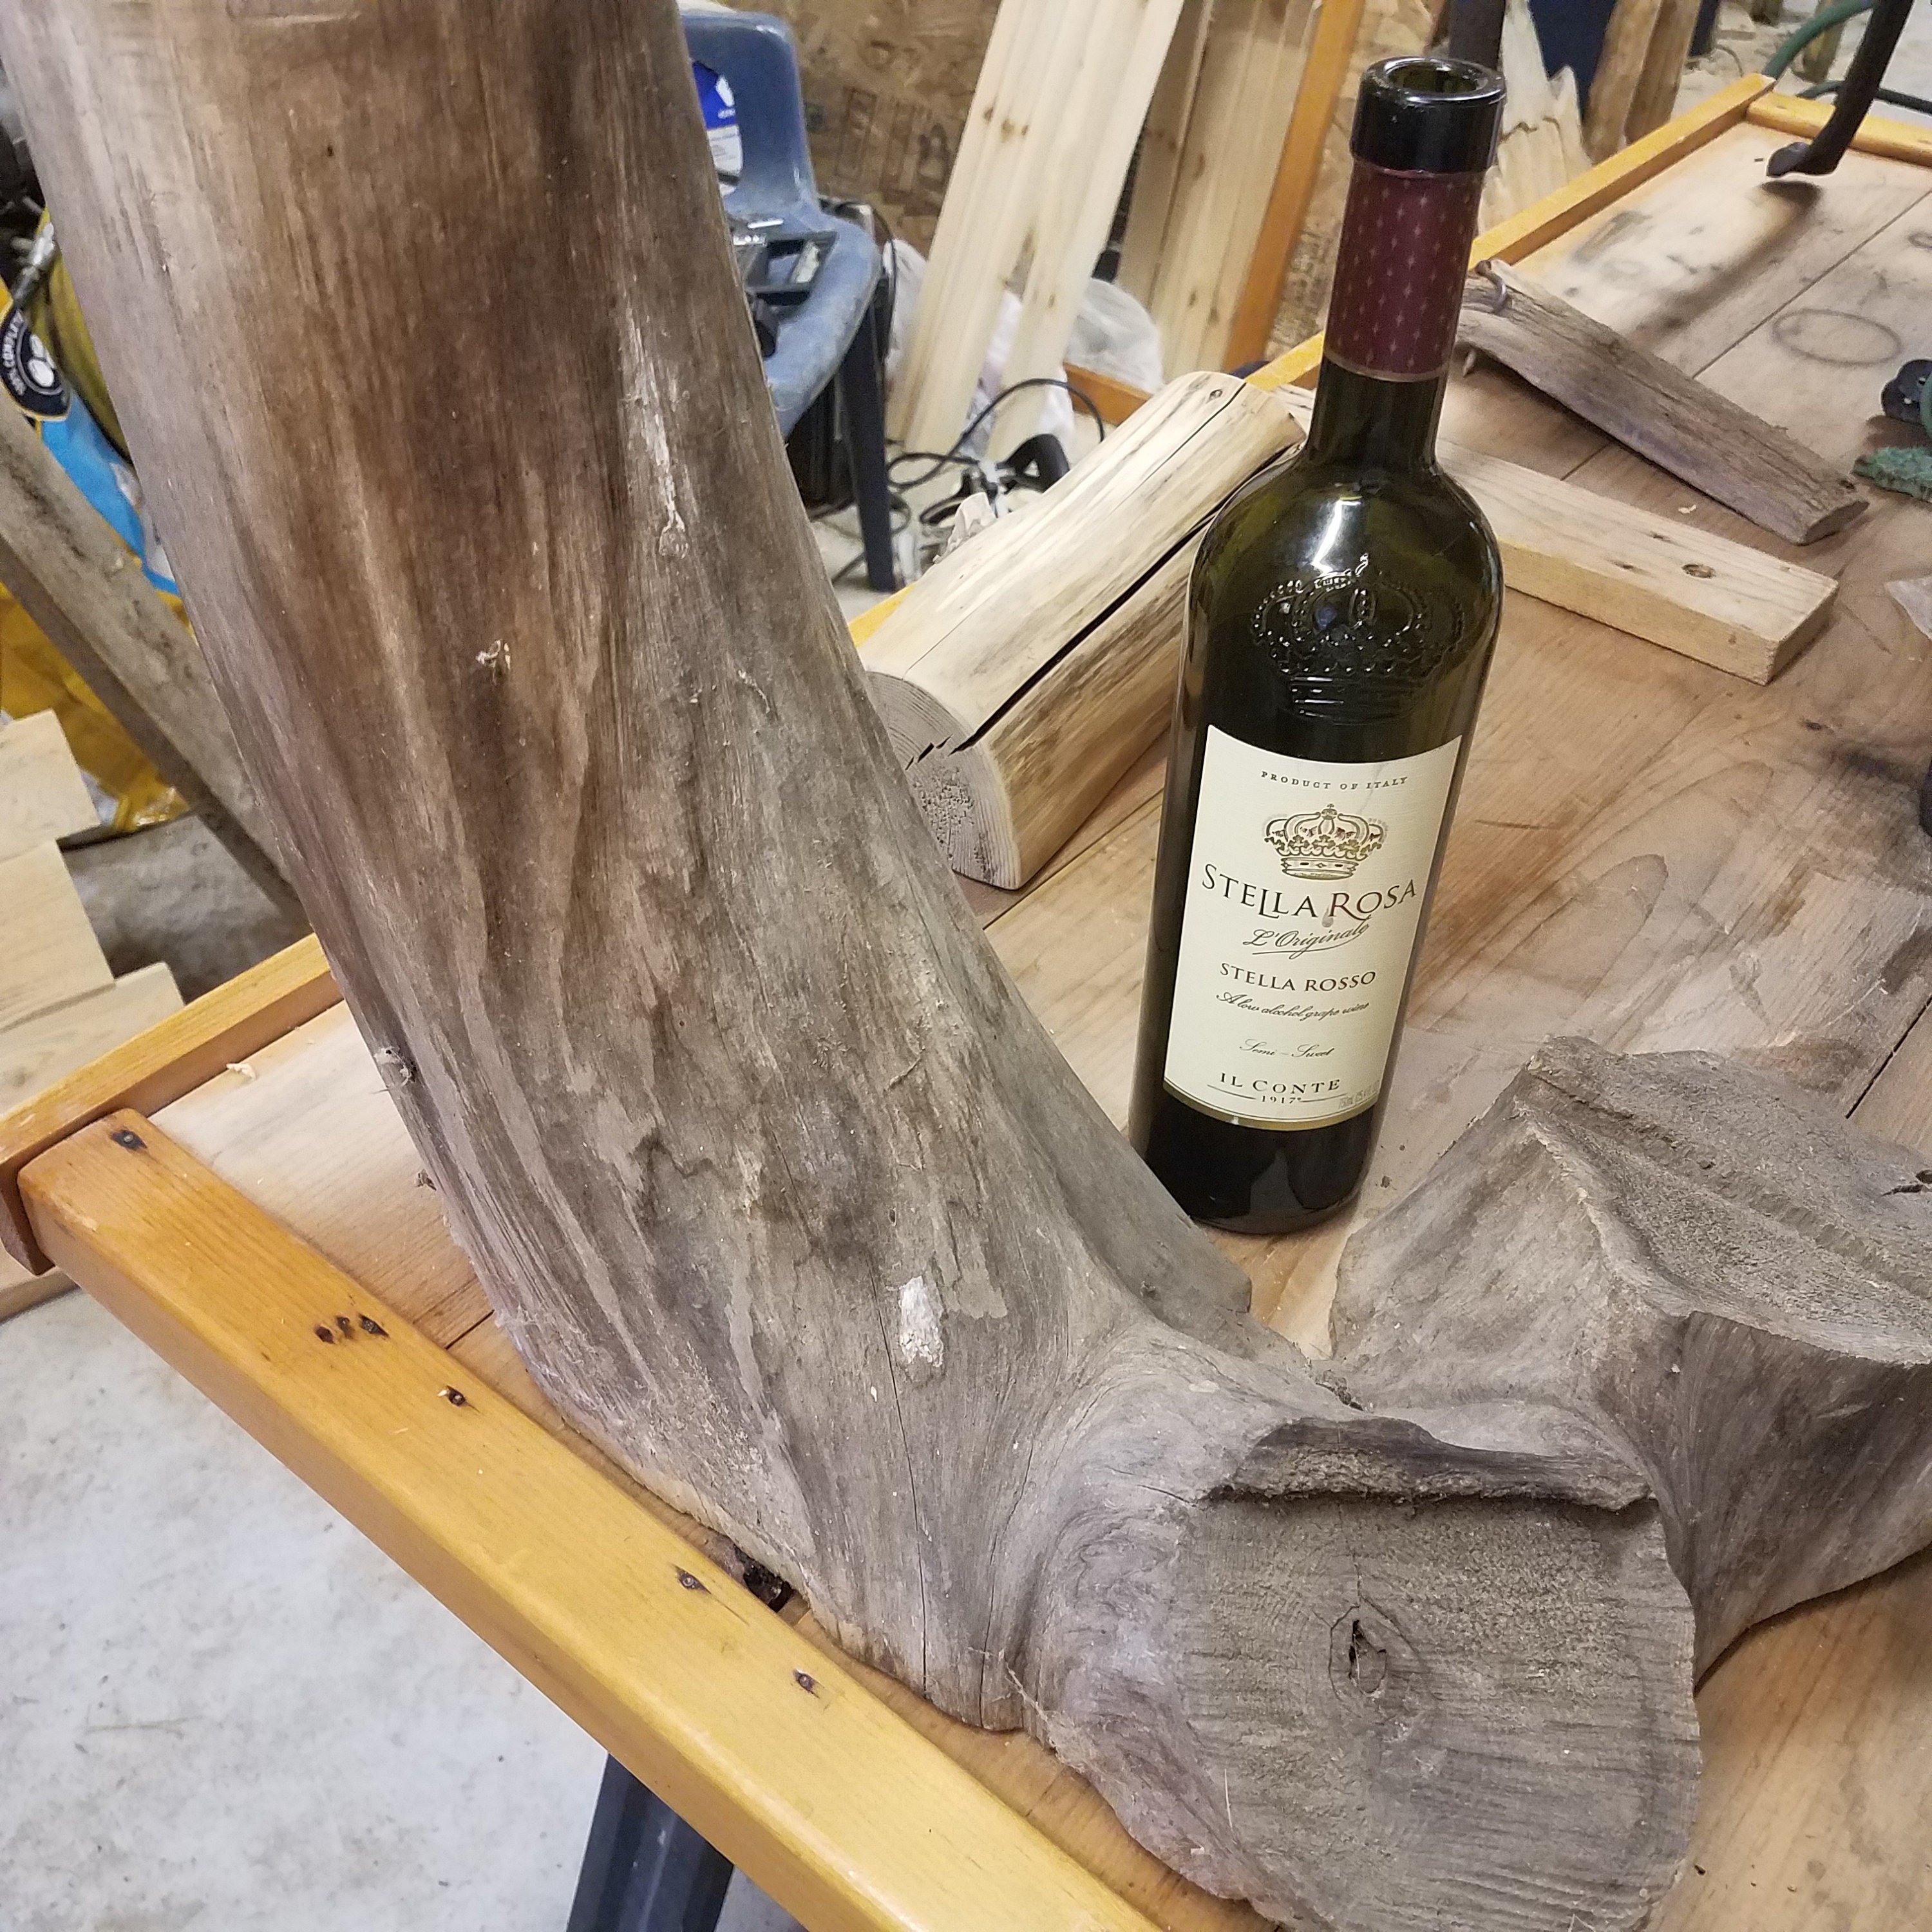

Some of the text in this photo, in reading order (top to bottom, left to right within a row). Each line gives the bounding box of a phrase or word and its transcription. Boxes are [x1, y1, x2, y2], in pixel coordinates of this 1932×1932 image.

[1261, 771, 1331, 789] PRODUCT
[1366, 777, 1408, 789] ITALY
[1202, 864, 1416, 920] STELLA ROSA
[1242, 914, 1372, 960] L'Originale
[1220, 963, 1376, 992] STELLA ROSSO
[1217, 992, 1370, 1021] A low alcohol grape wine
[1220, 1072, 1243, 1088] IL
[1253, 1079, 1340, 1094] CONTE
